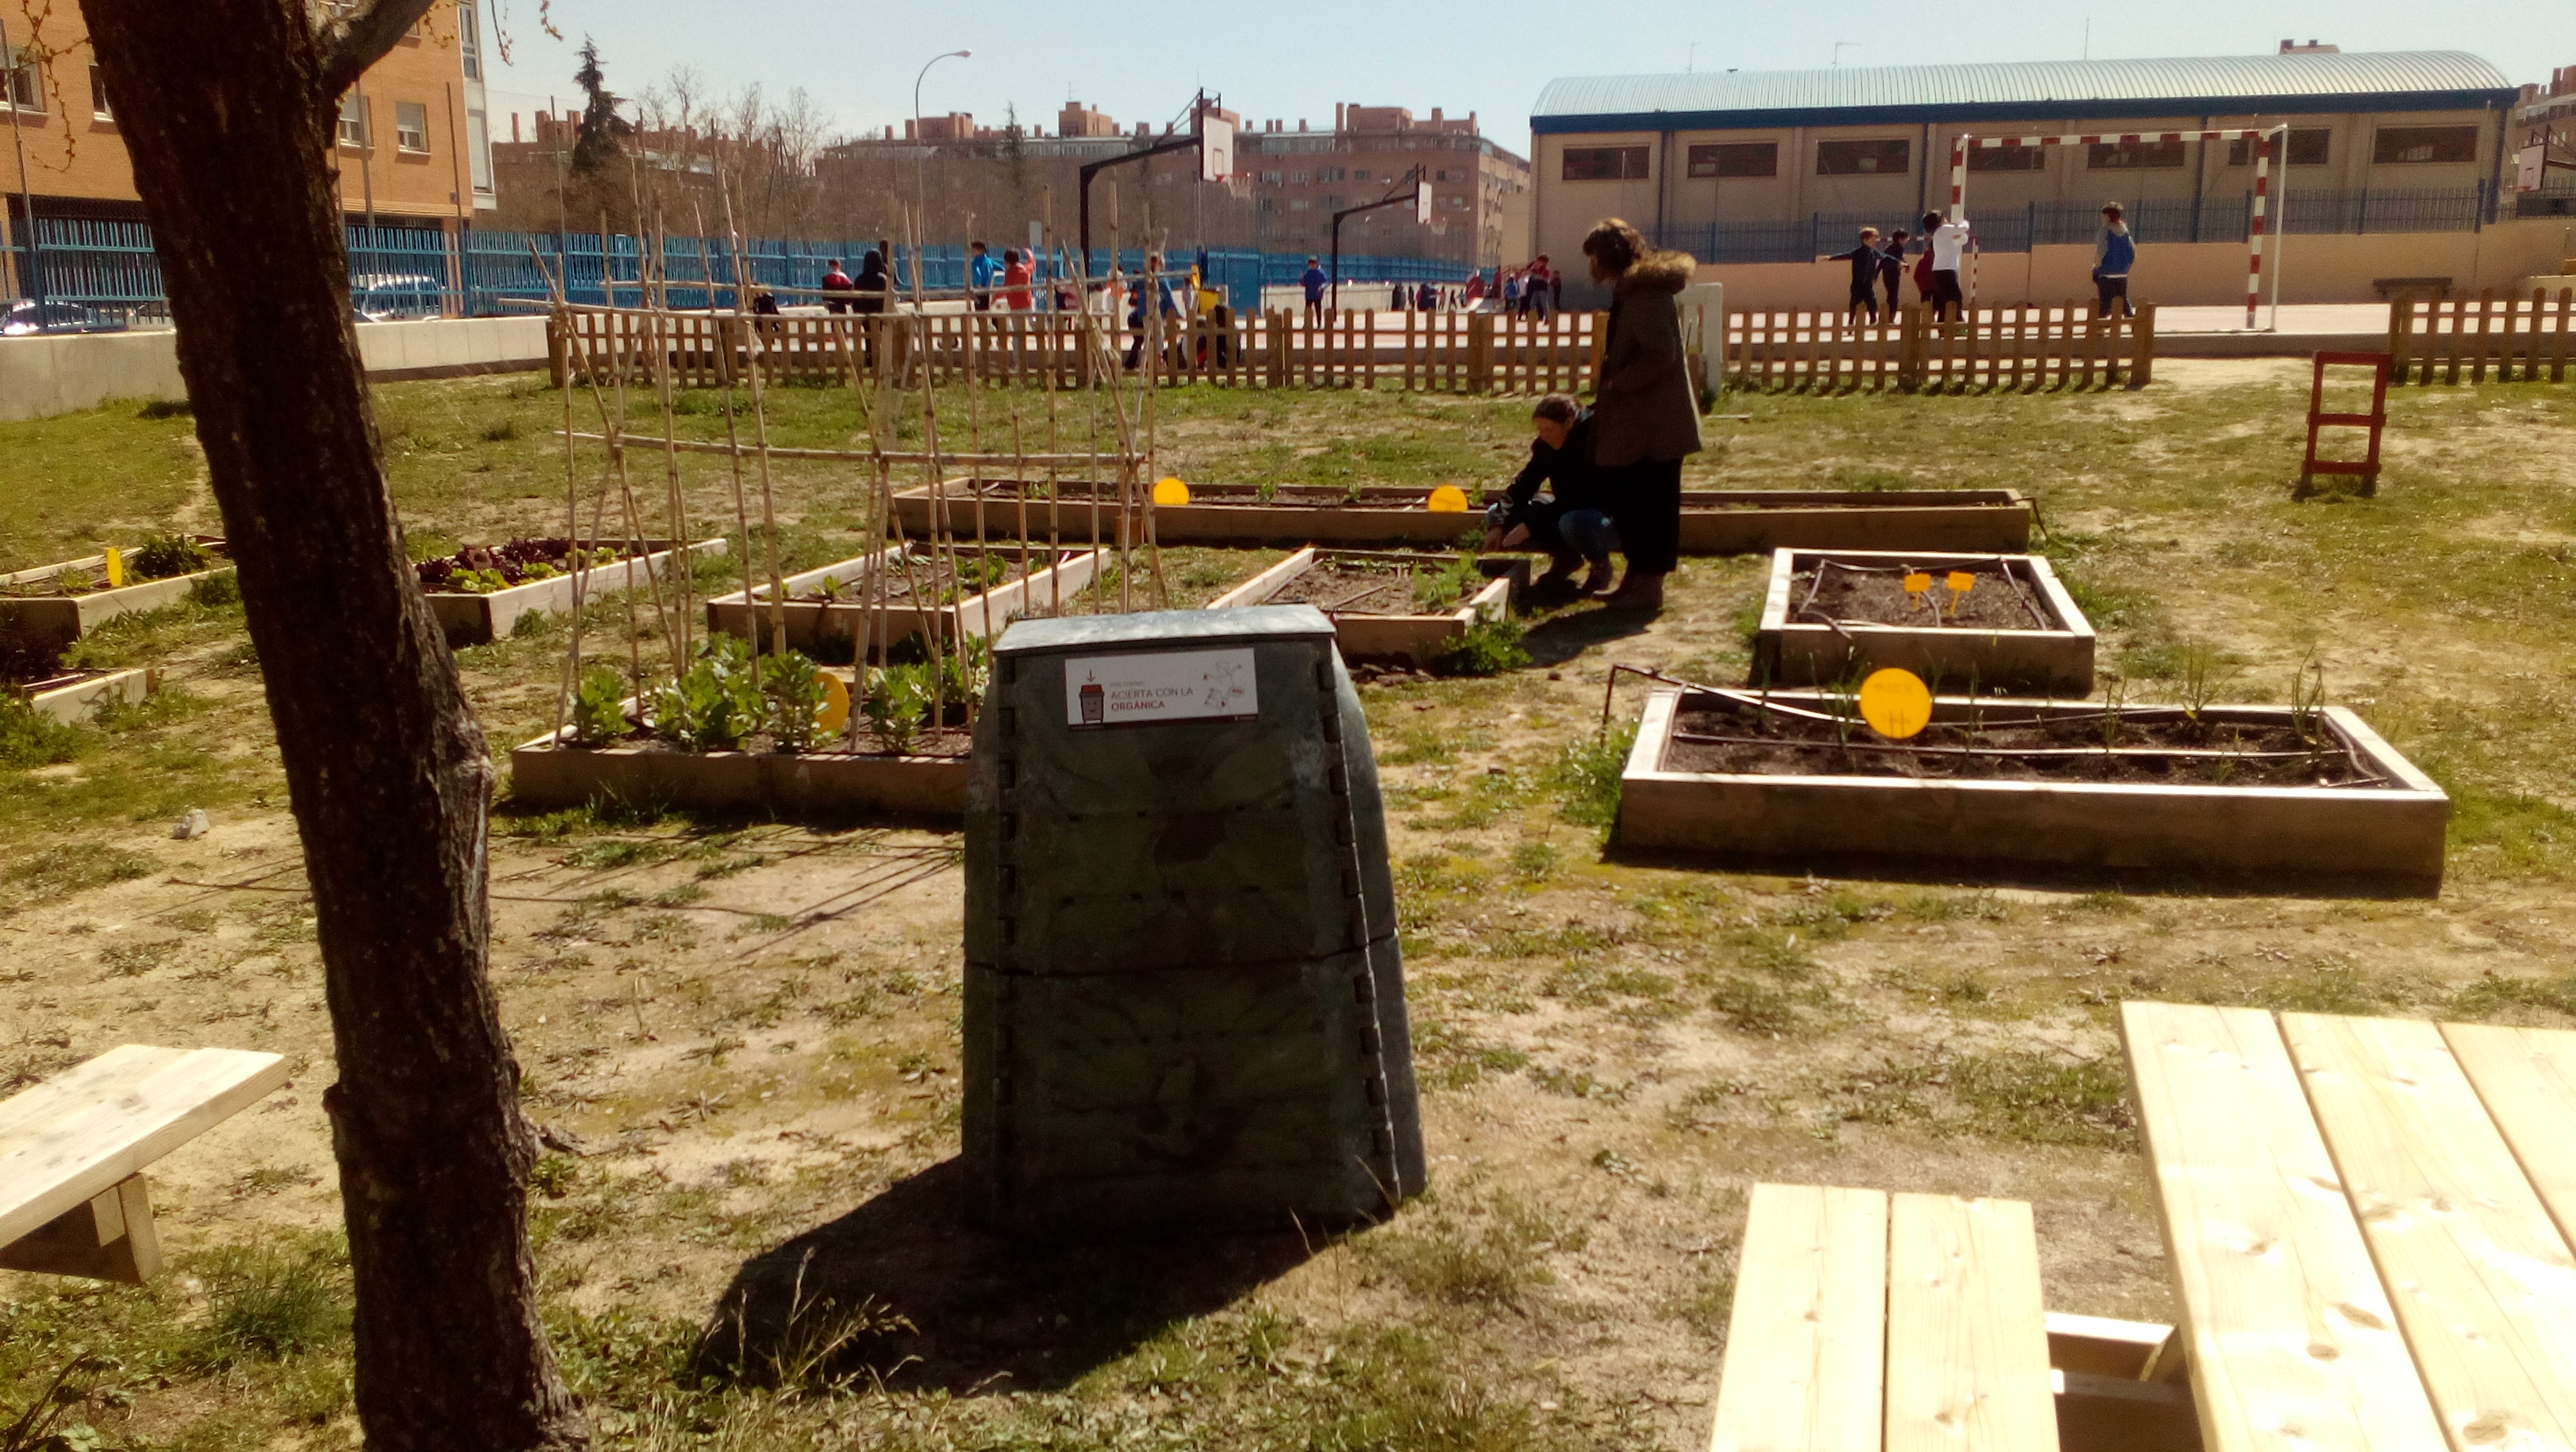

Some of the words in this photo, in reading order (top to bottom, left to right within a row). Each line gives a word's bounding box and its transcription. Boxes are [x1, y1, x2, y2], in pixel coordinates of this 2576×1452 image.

[1111, 689, 1153, 699] ACIERTA
[1155, 687, 1178, 697] CON
[1181, 687, 1193, 697] LA
[1111, 700, 1165, 712] ORGÁNICA
